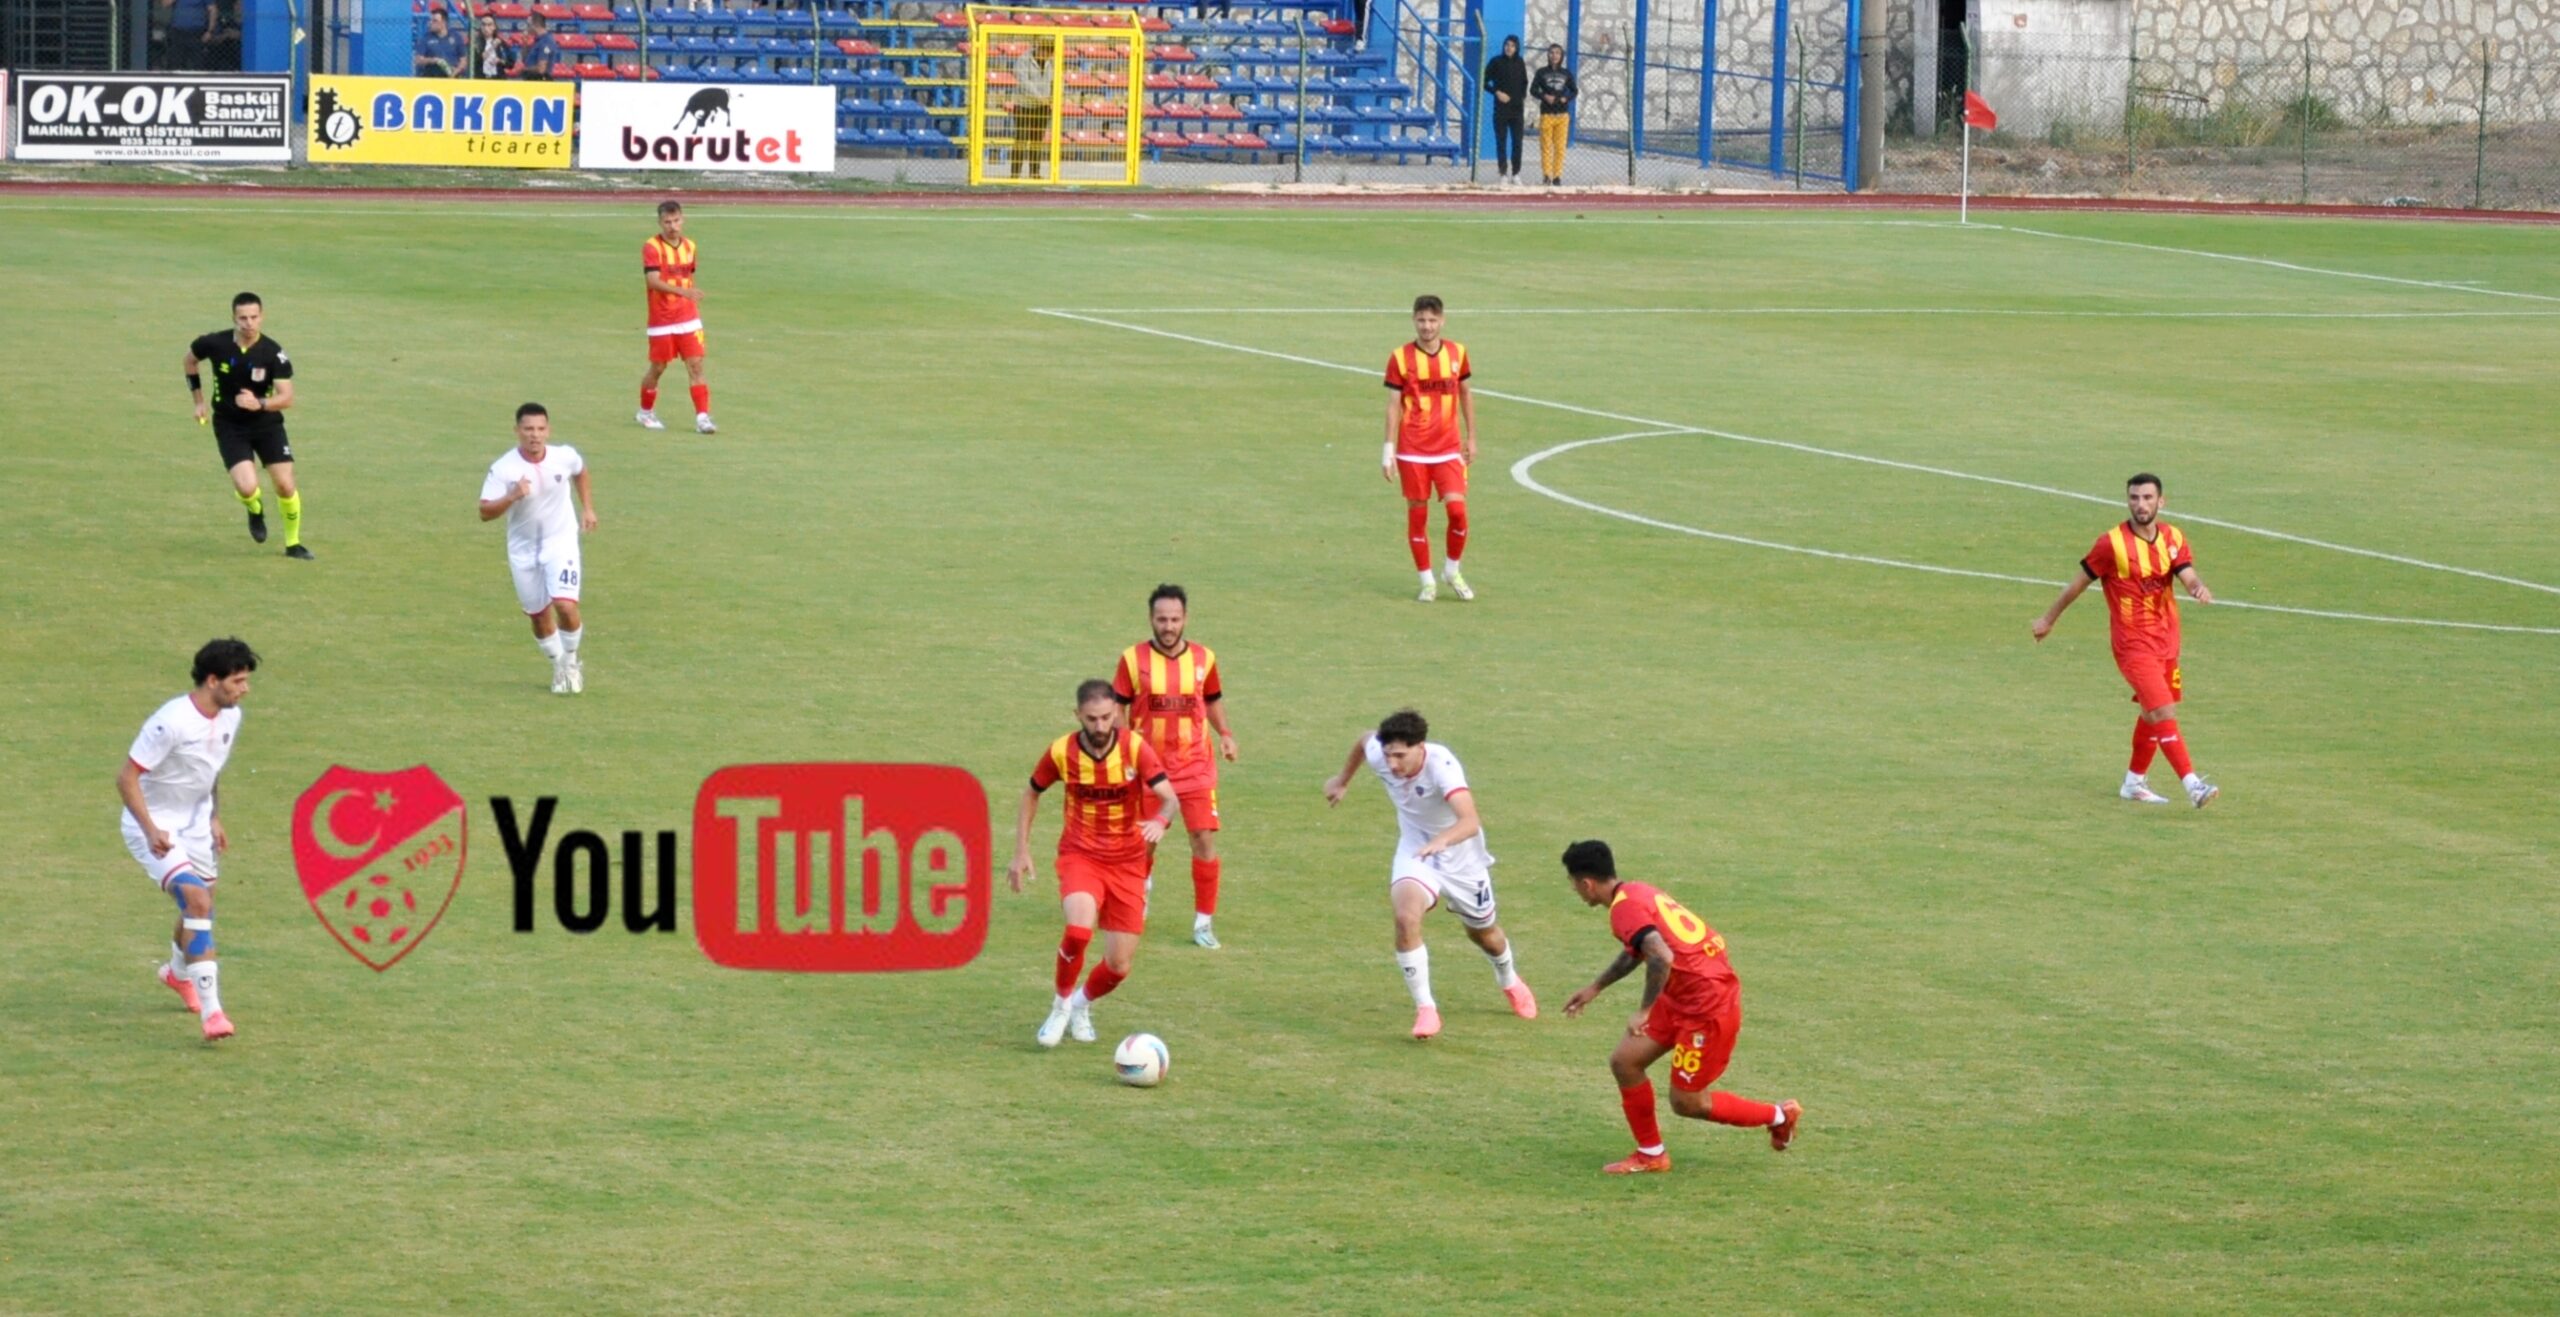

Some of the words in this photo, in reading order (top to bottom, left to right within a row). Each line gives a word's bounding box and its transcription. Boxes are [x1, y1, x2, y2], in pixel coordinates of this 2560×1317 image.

[29, 85, 195, 124] OK-OK
[205, 91, 279, 105] Baskül
[205, 105, 279, 122] Sanayii
[372, 93, 566, 134] BAKAN
[28, 124, 83, 137] MAKİNA
[87, 126, 97, 137] &
[101, 126, 141, 137] TARTI
[466, 136, 562, 155] ticaret
[623, 126, 802, 163] barutet
[559, 568, 578, 586] 48
[1474, 887, 1490, 907] 14
[1671, 1044, 1702, 1073] 66
